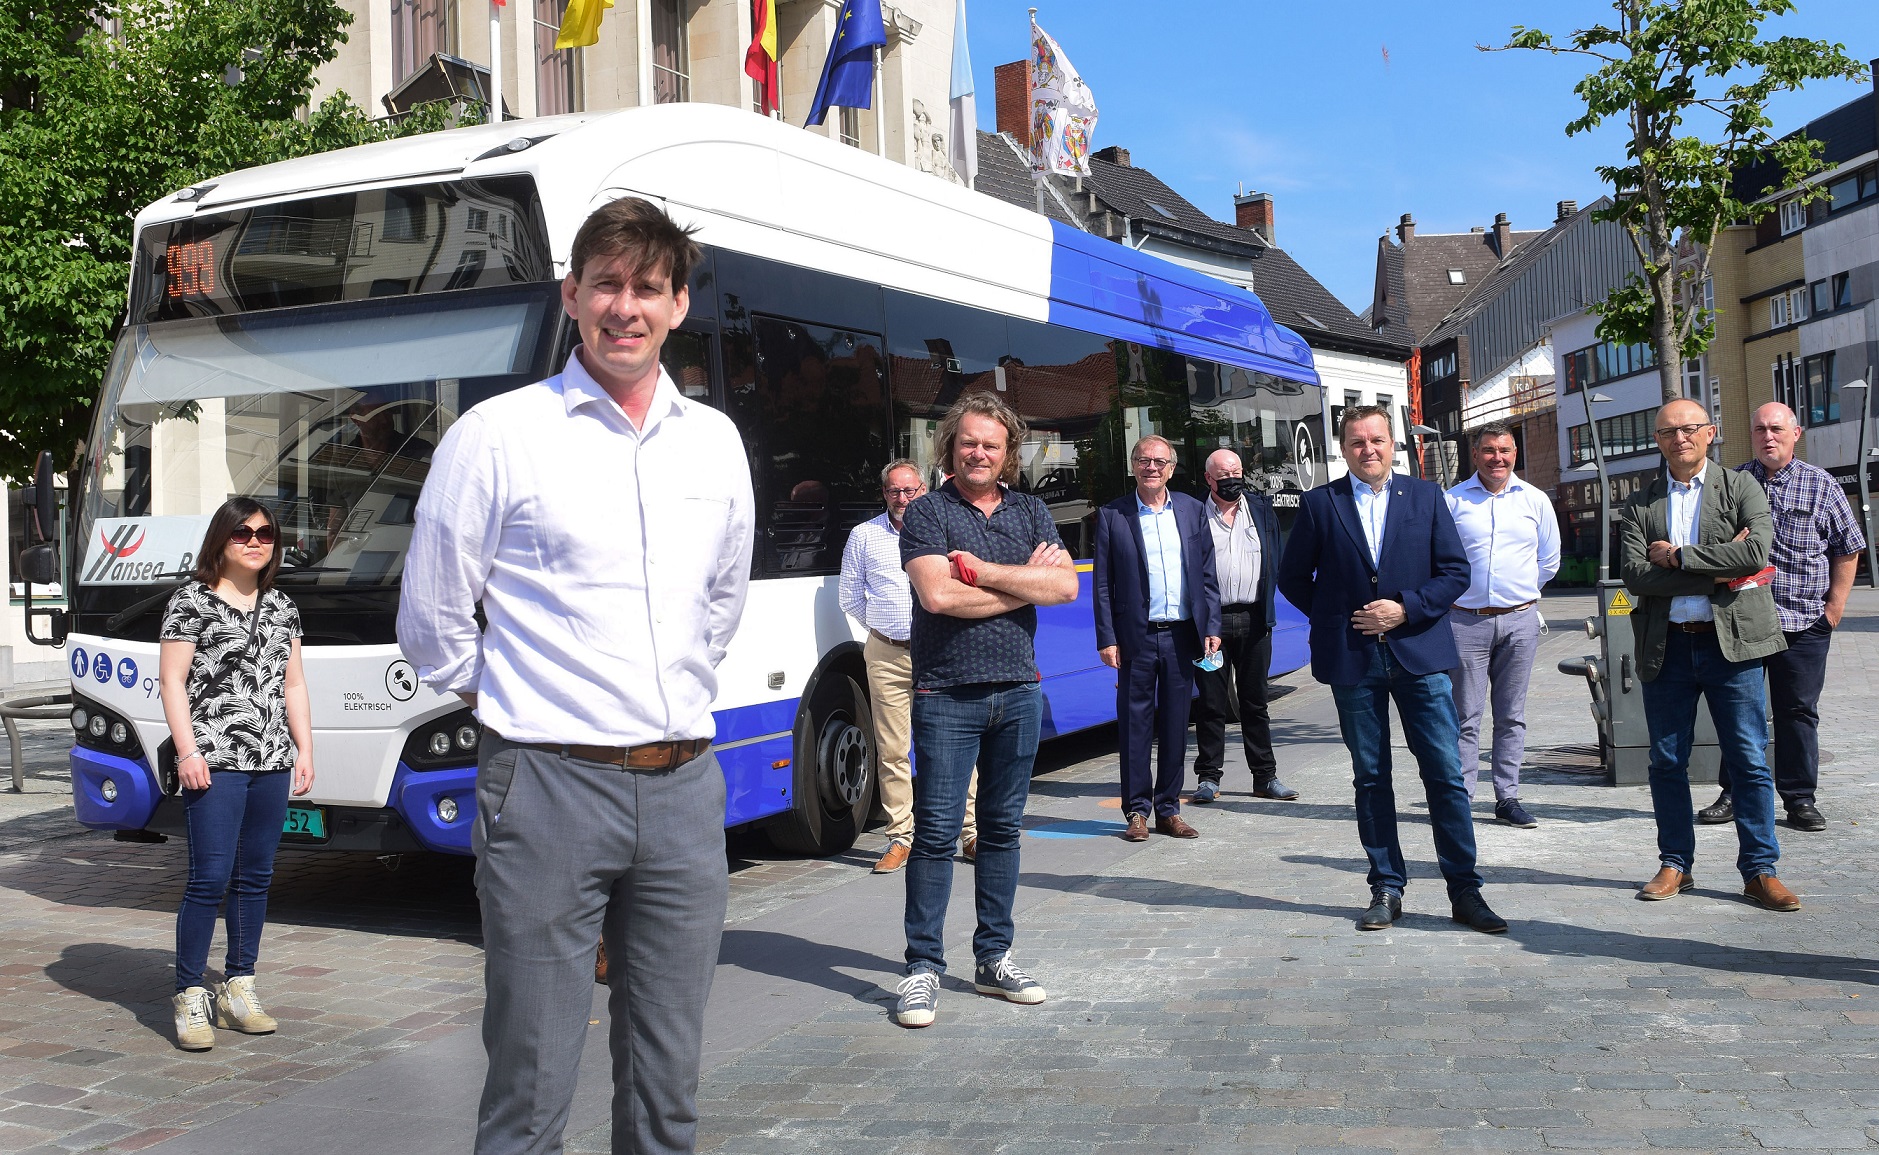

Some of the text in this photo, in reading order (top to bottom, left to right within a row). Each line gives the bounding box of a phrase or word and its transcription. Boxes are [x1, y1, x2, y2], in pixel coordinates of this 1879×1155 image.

[167, 241, 214, 297] 999
[1584, 476, 1641, 505] ENGMA
[343, 692, 365, 701] 100%
[344, 702, 392, 711] ELEKTRISCH
